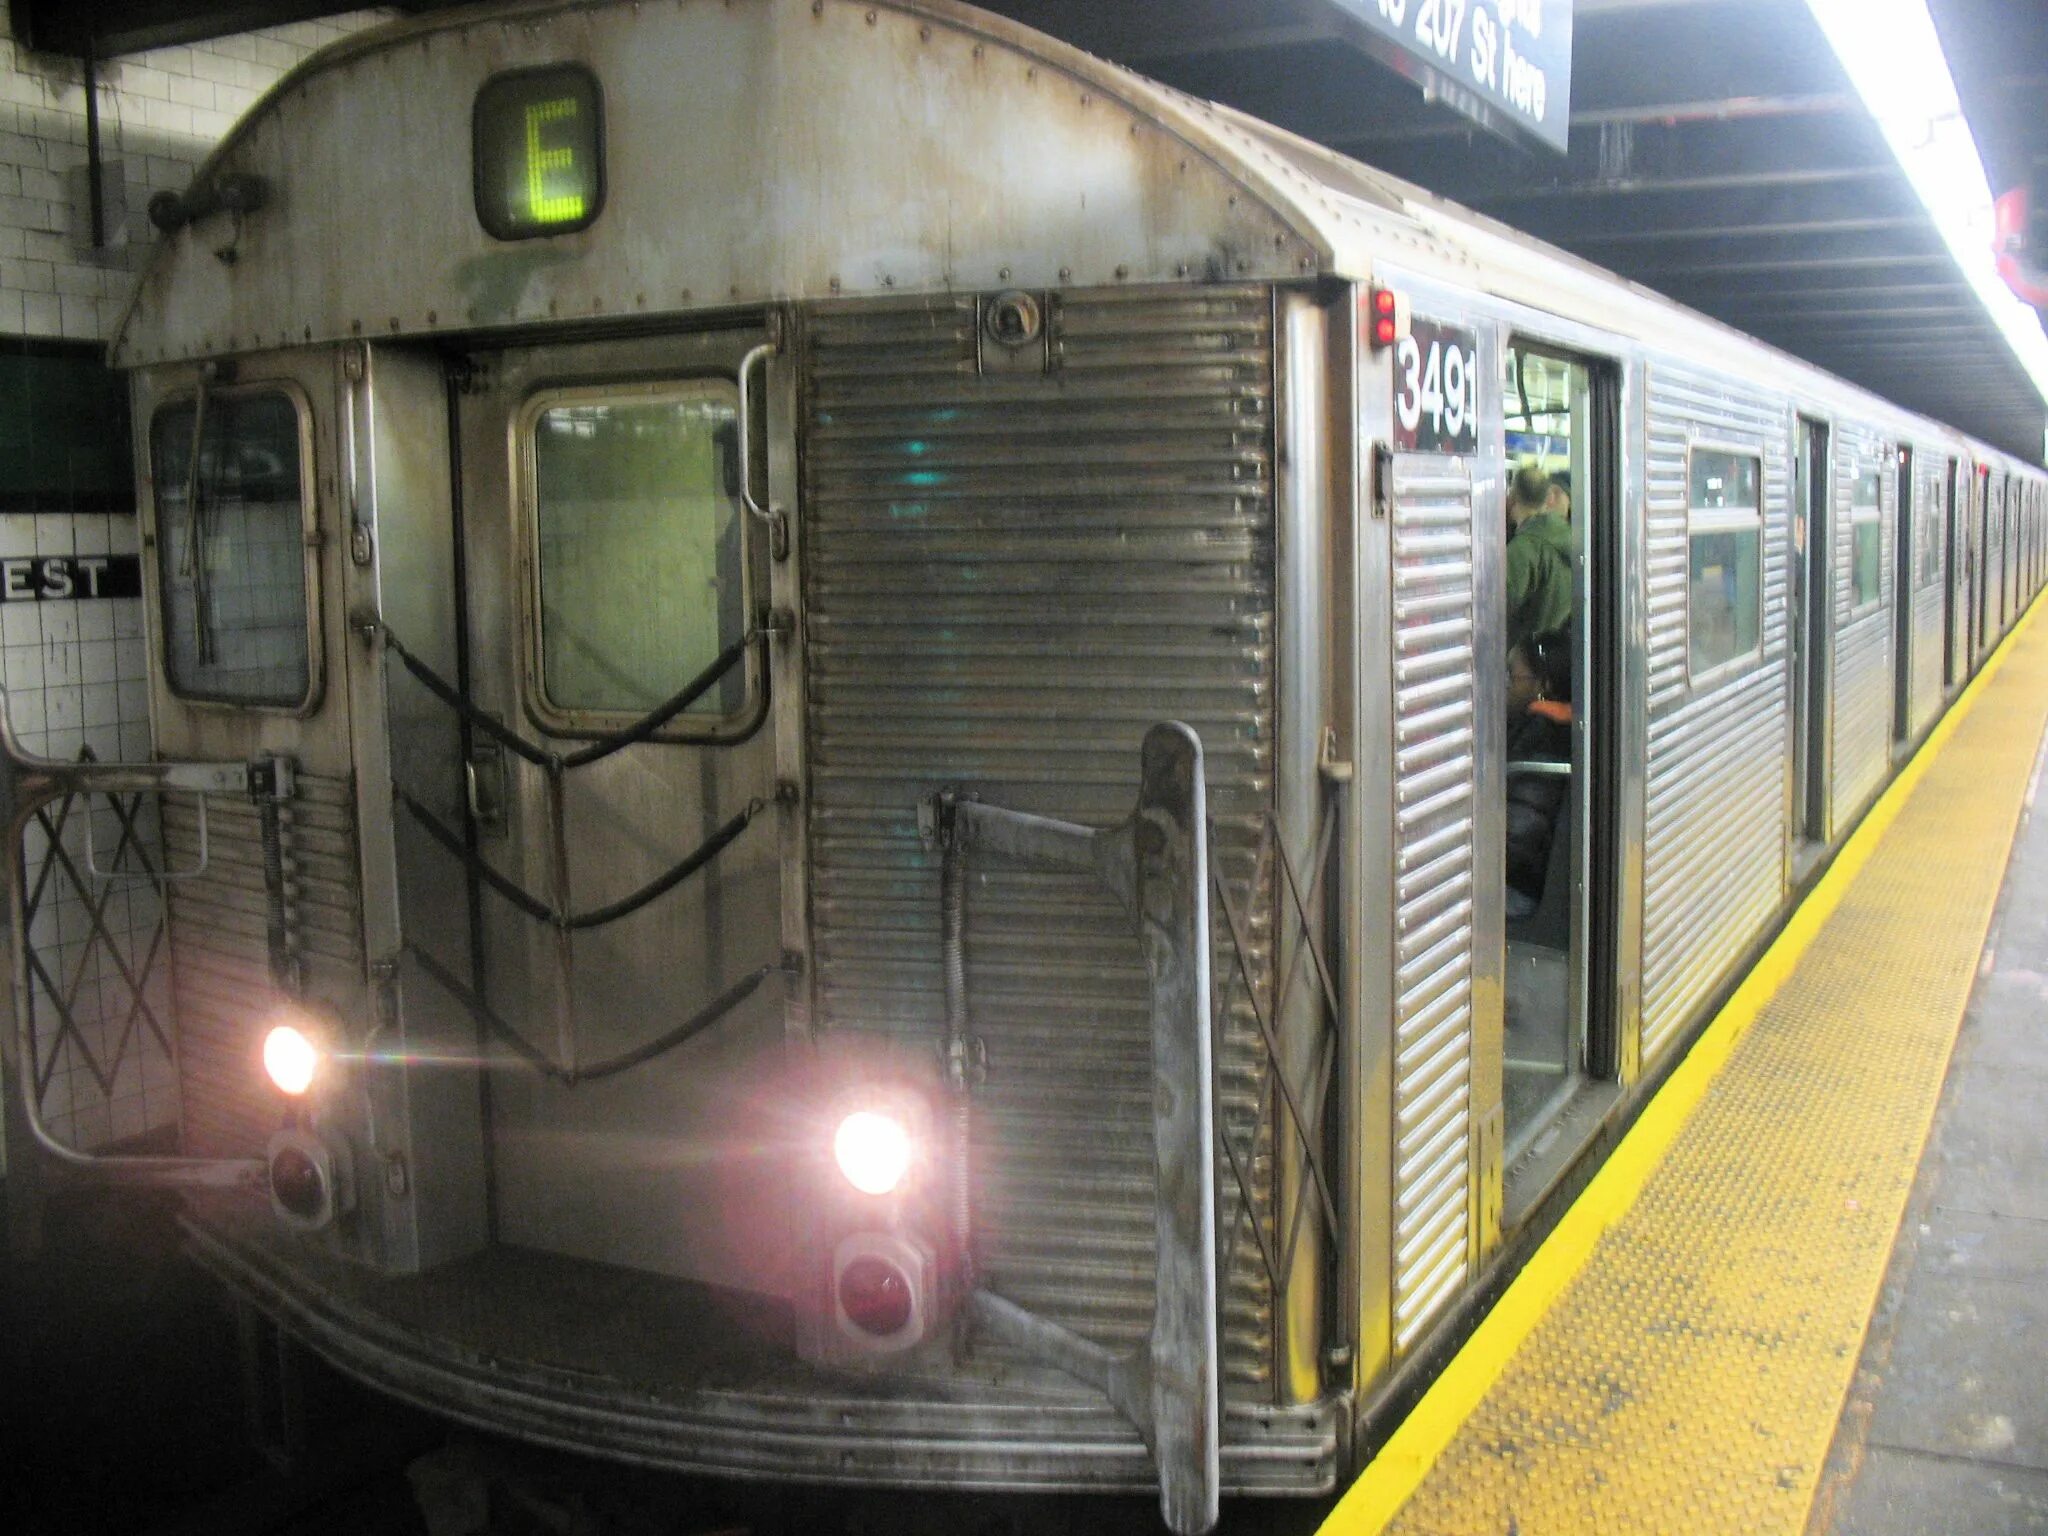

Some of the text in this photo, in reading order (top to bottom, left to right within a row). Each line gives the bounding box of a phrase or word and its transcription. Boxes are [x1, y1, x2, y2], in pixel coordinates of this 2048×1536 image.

[1415, 0, 1465, 63] 207
[1470, 6, 1497, 91] St
[1502, 29, 1545, 122] here
[526, 98, 584, 223] E
[1397, 335, 1477, 438] 3491
[2, 558, 108, 599] EST
